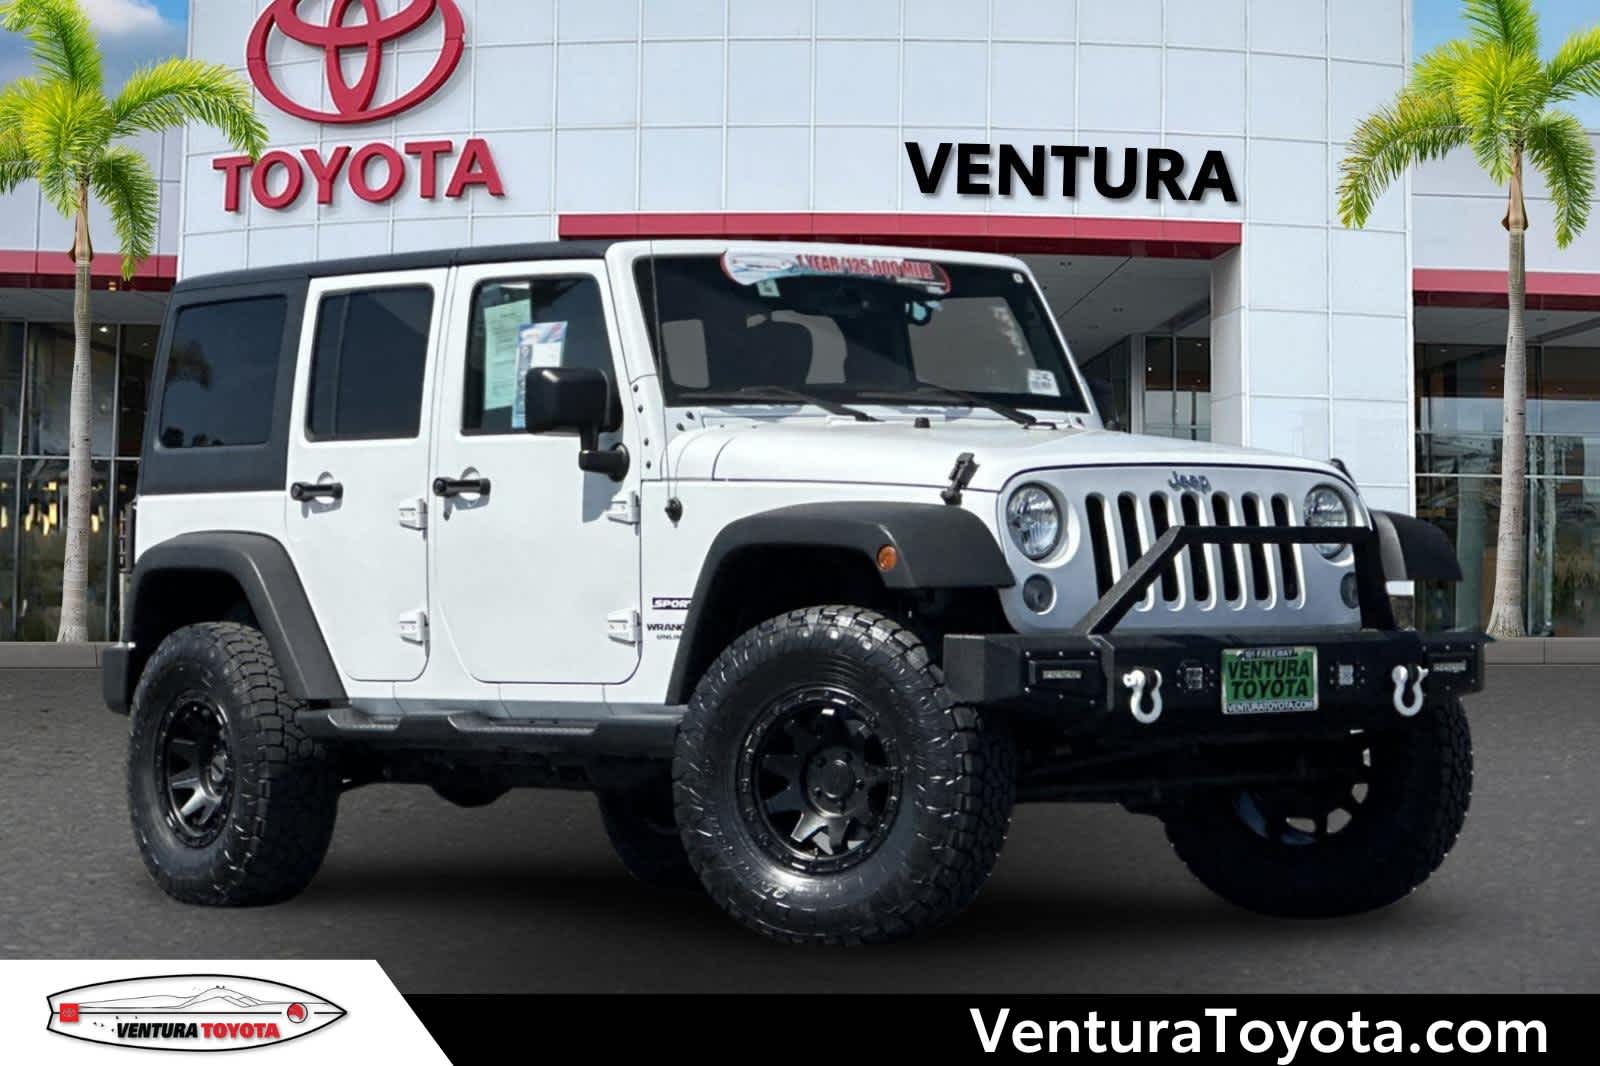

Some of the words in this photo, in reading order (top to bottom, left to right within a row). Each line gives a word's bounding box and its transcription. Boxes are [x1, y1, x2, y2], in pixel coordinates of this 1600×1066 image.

[213, 138, 505, 212] TOYOTA
[904, 141, 1239, 202] VENTURA
[1168, 471, 1212, 494] Jeep
[652, 598, 691, 609] SPOR
[1228, 660, 1310, 680] VENTURA
[1231, 679, 1308, 699] TOYOTA
